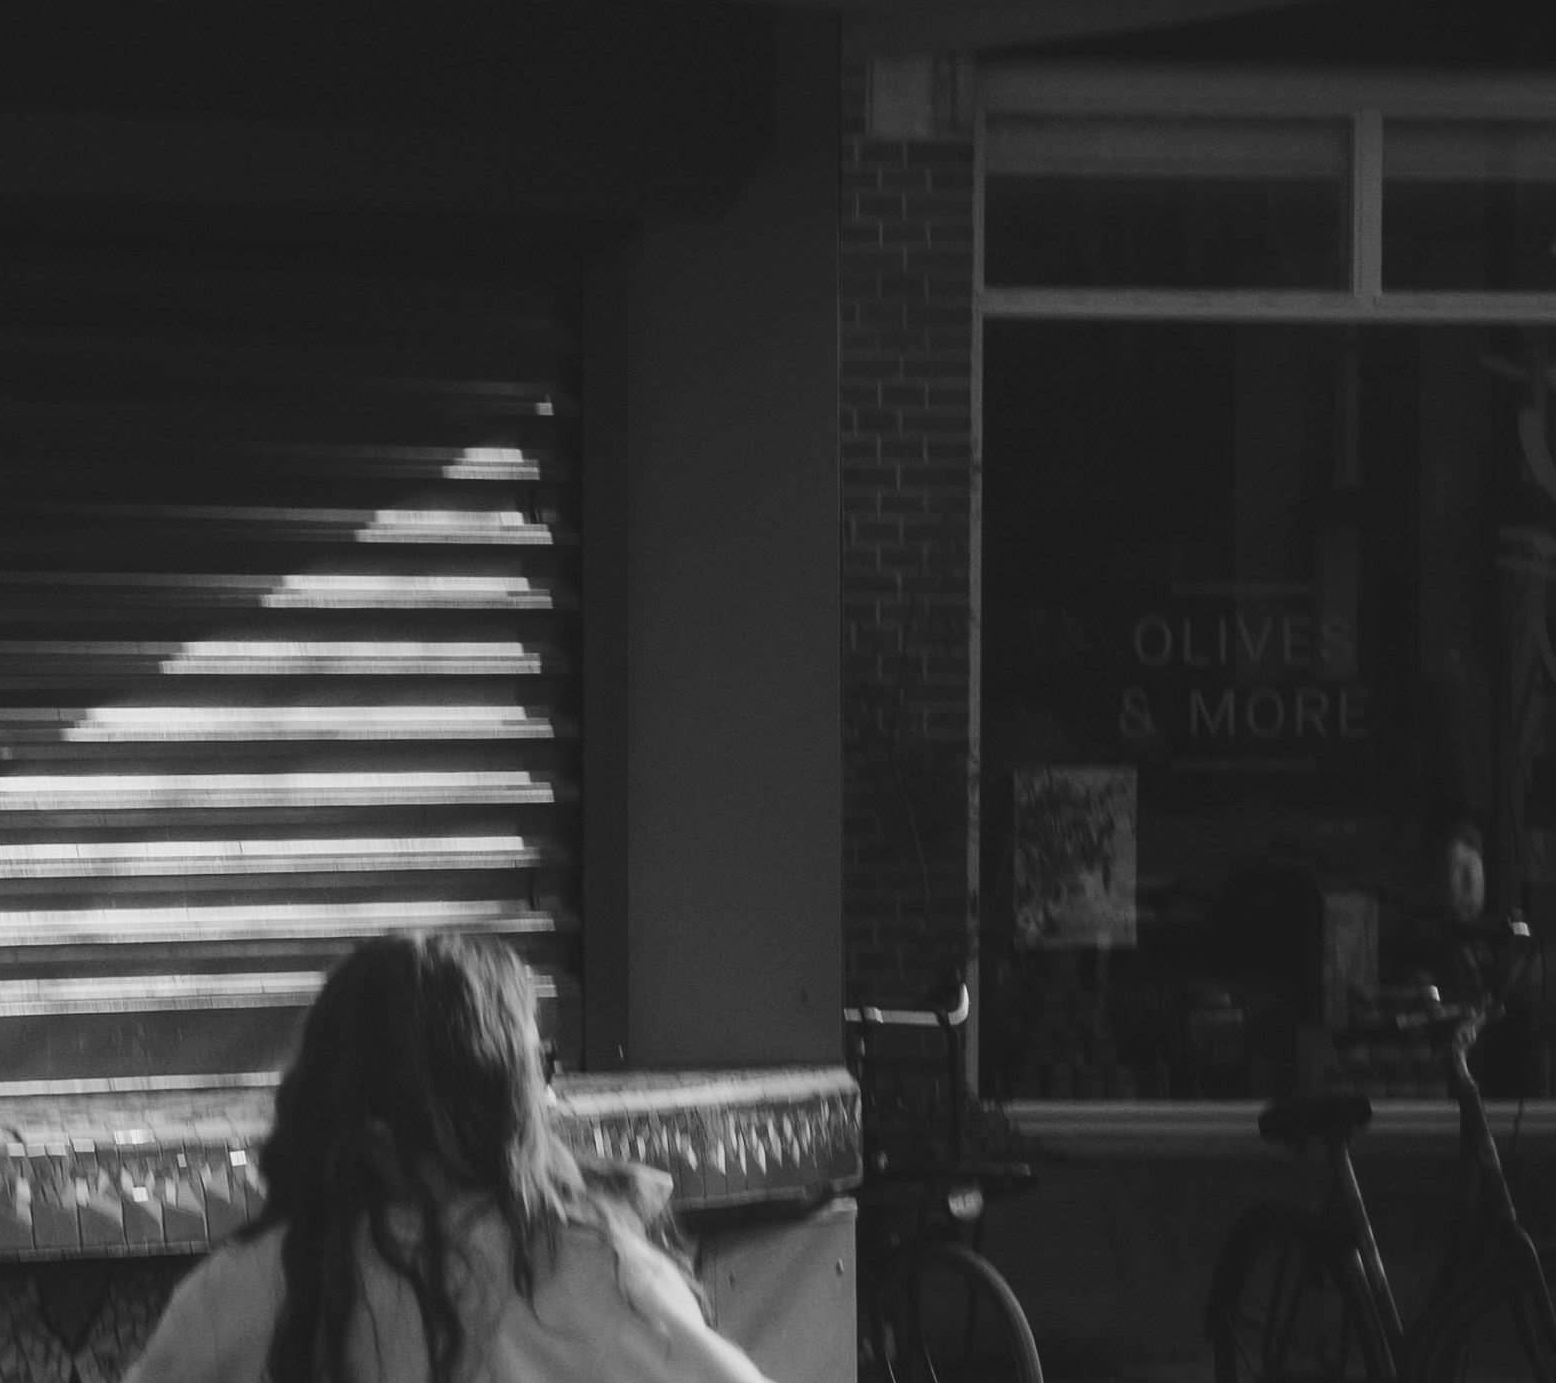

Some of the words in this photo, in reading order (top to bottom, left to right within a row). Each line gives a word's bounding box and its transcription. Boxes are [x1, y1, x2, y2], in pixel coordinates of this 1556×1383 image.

[1133, 613, 1356, 668] OLIVES
[1118, 686, 1158, 741] &
[1189, 686, 1370, 740] MORE
